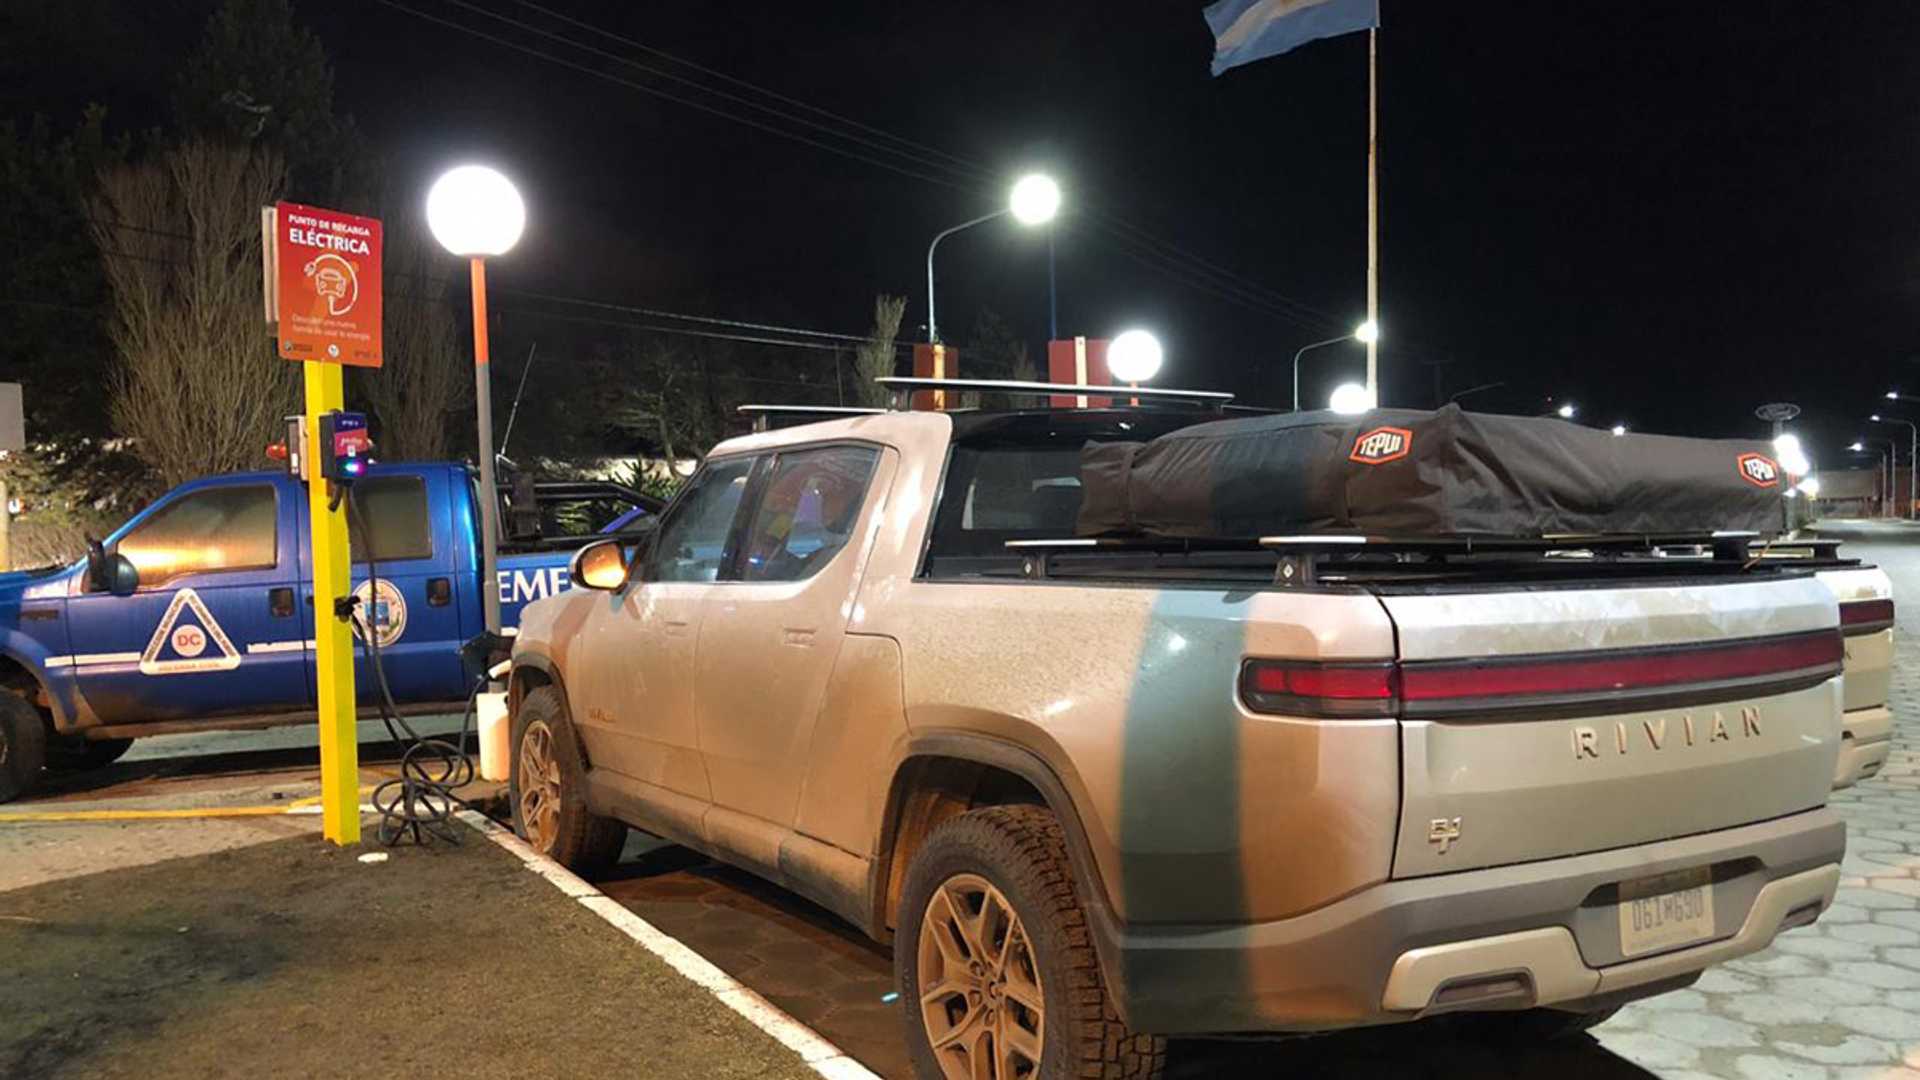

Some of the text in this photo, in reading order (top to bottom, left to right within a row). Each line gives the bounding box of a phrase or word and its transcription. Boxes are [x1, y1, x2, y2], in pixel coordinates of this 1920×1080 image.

[288, 214, 317, 227] PUNTO
[319, 220, 330, 230] DE
[289, 228, 370, 255] ELÉCTRICA
[1360, 432, 1401, 457] TEPUI
[177, 634, 201, 646] DC
[1571, 706, 1760, 759] RIVIAN
